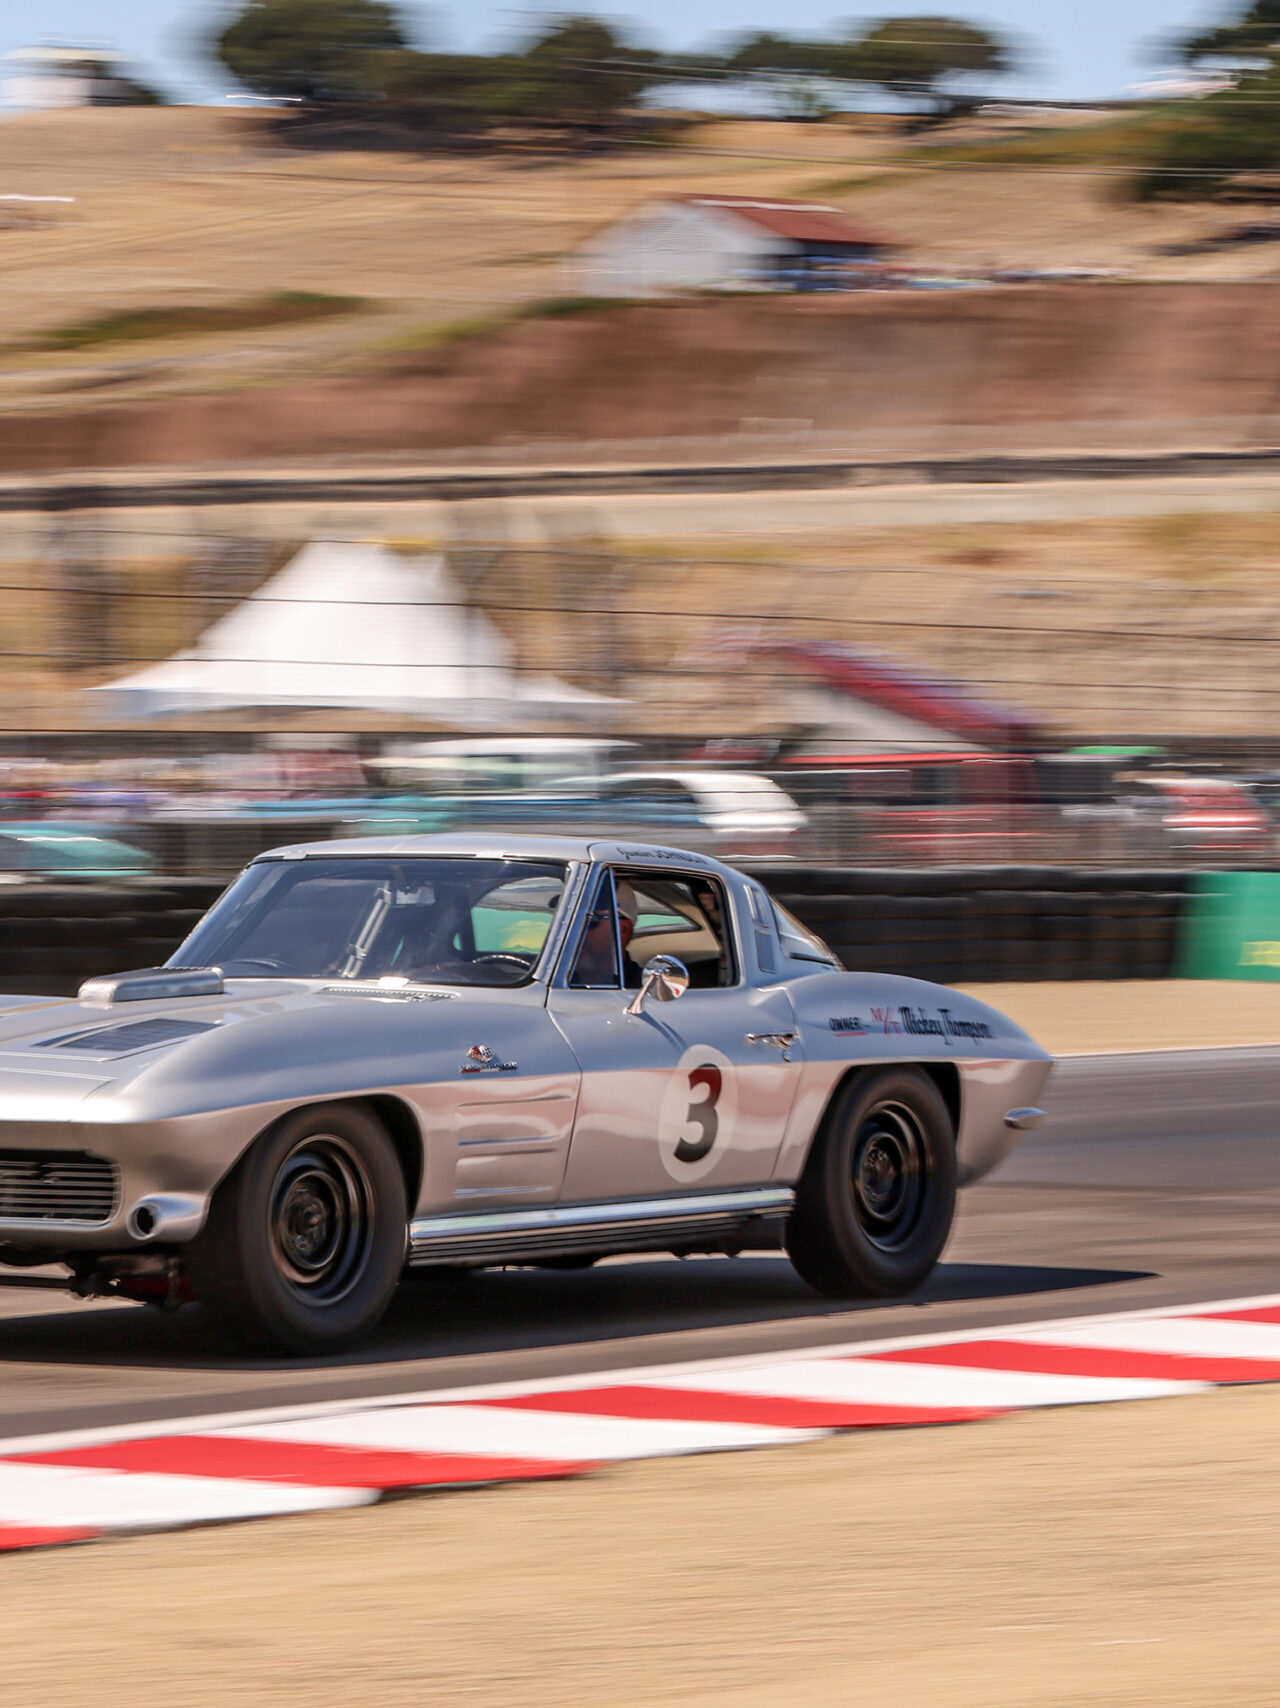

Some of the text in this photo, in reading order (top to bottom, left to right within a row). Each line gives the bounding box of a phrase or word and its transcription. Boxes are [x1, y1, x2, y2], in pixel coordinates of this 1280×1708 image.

[898, 1006, 945, 1036] Mickey
[937, 1008, 994, 1045] Thompson
[674, 1063, 722, 1163] 3
